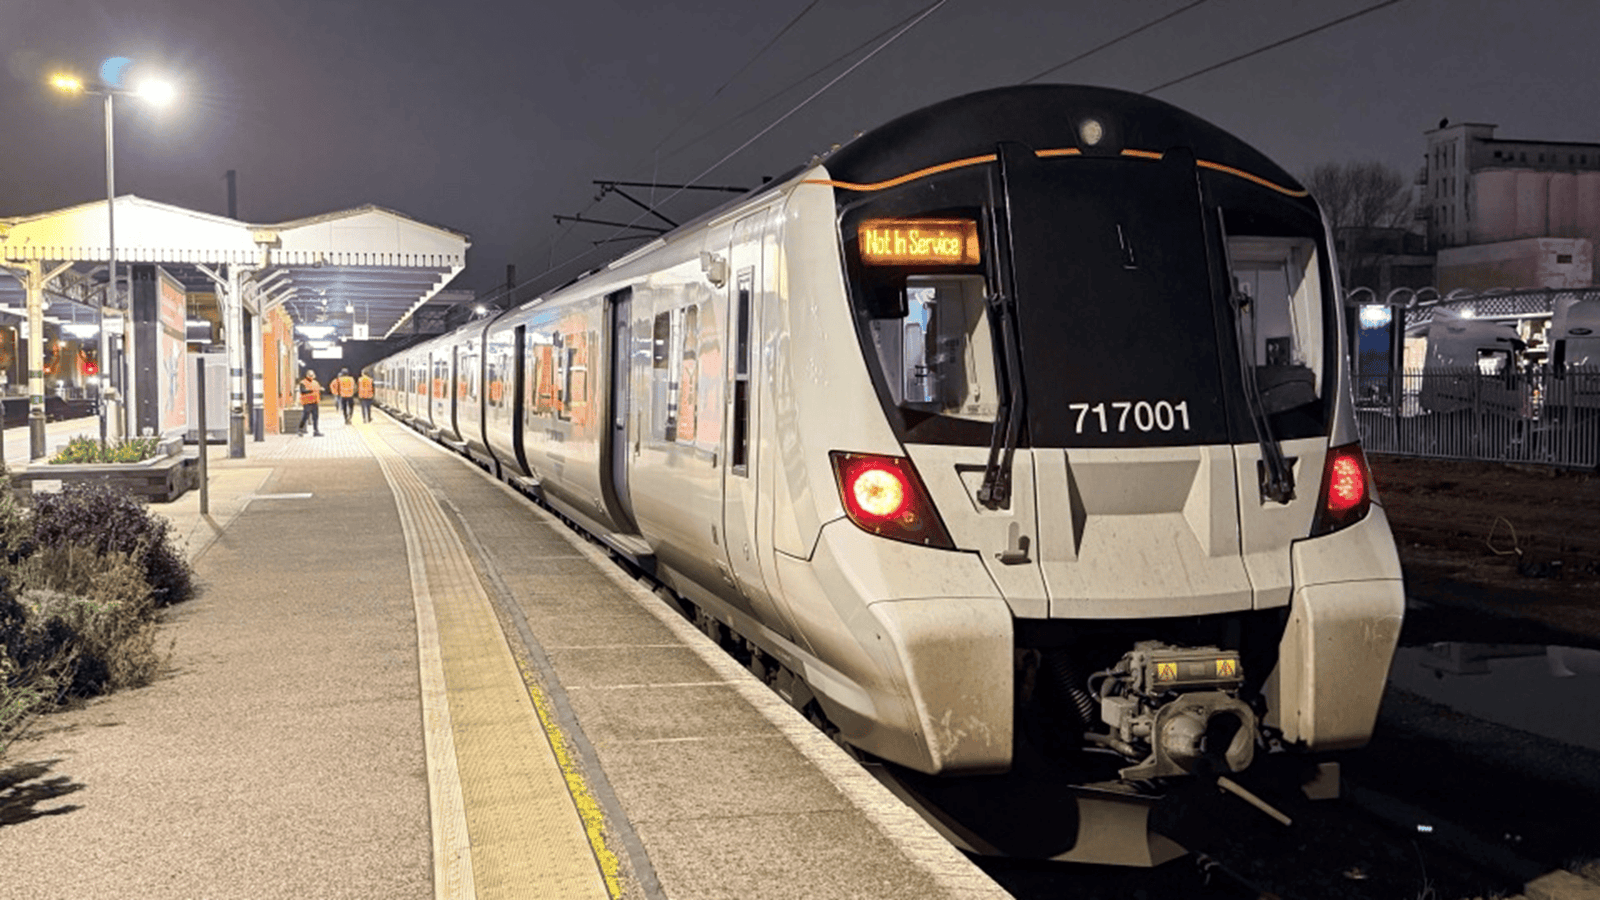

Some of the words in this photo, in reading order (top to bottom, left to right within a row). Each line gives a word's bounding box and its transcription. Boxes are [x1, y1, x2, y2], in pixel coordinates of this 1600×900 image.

[866, 229, 892, 255] Not
[894, 229, 906, 255] In
[909, 229, 960, 255] Service
[1068, 400, 1190, 434] 717001
